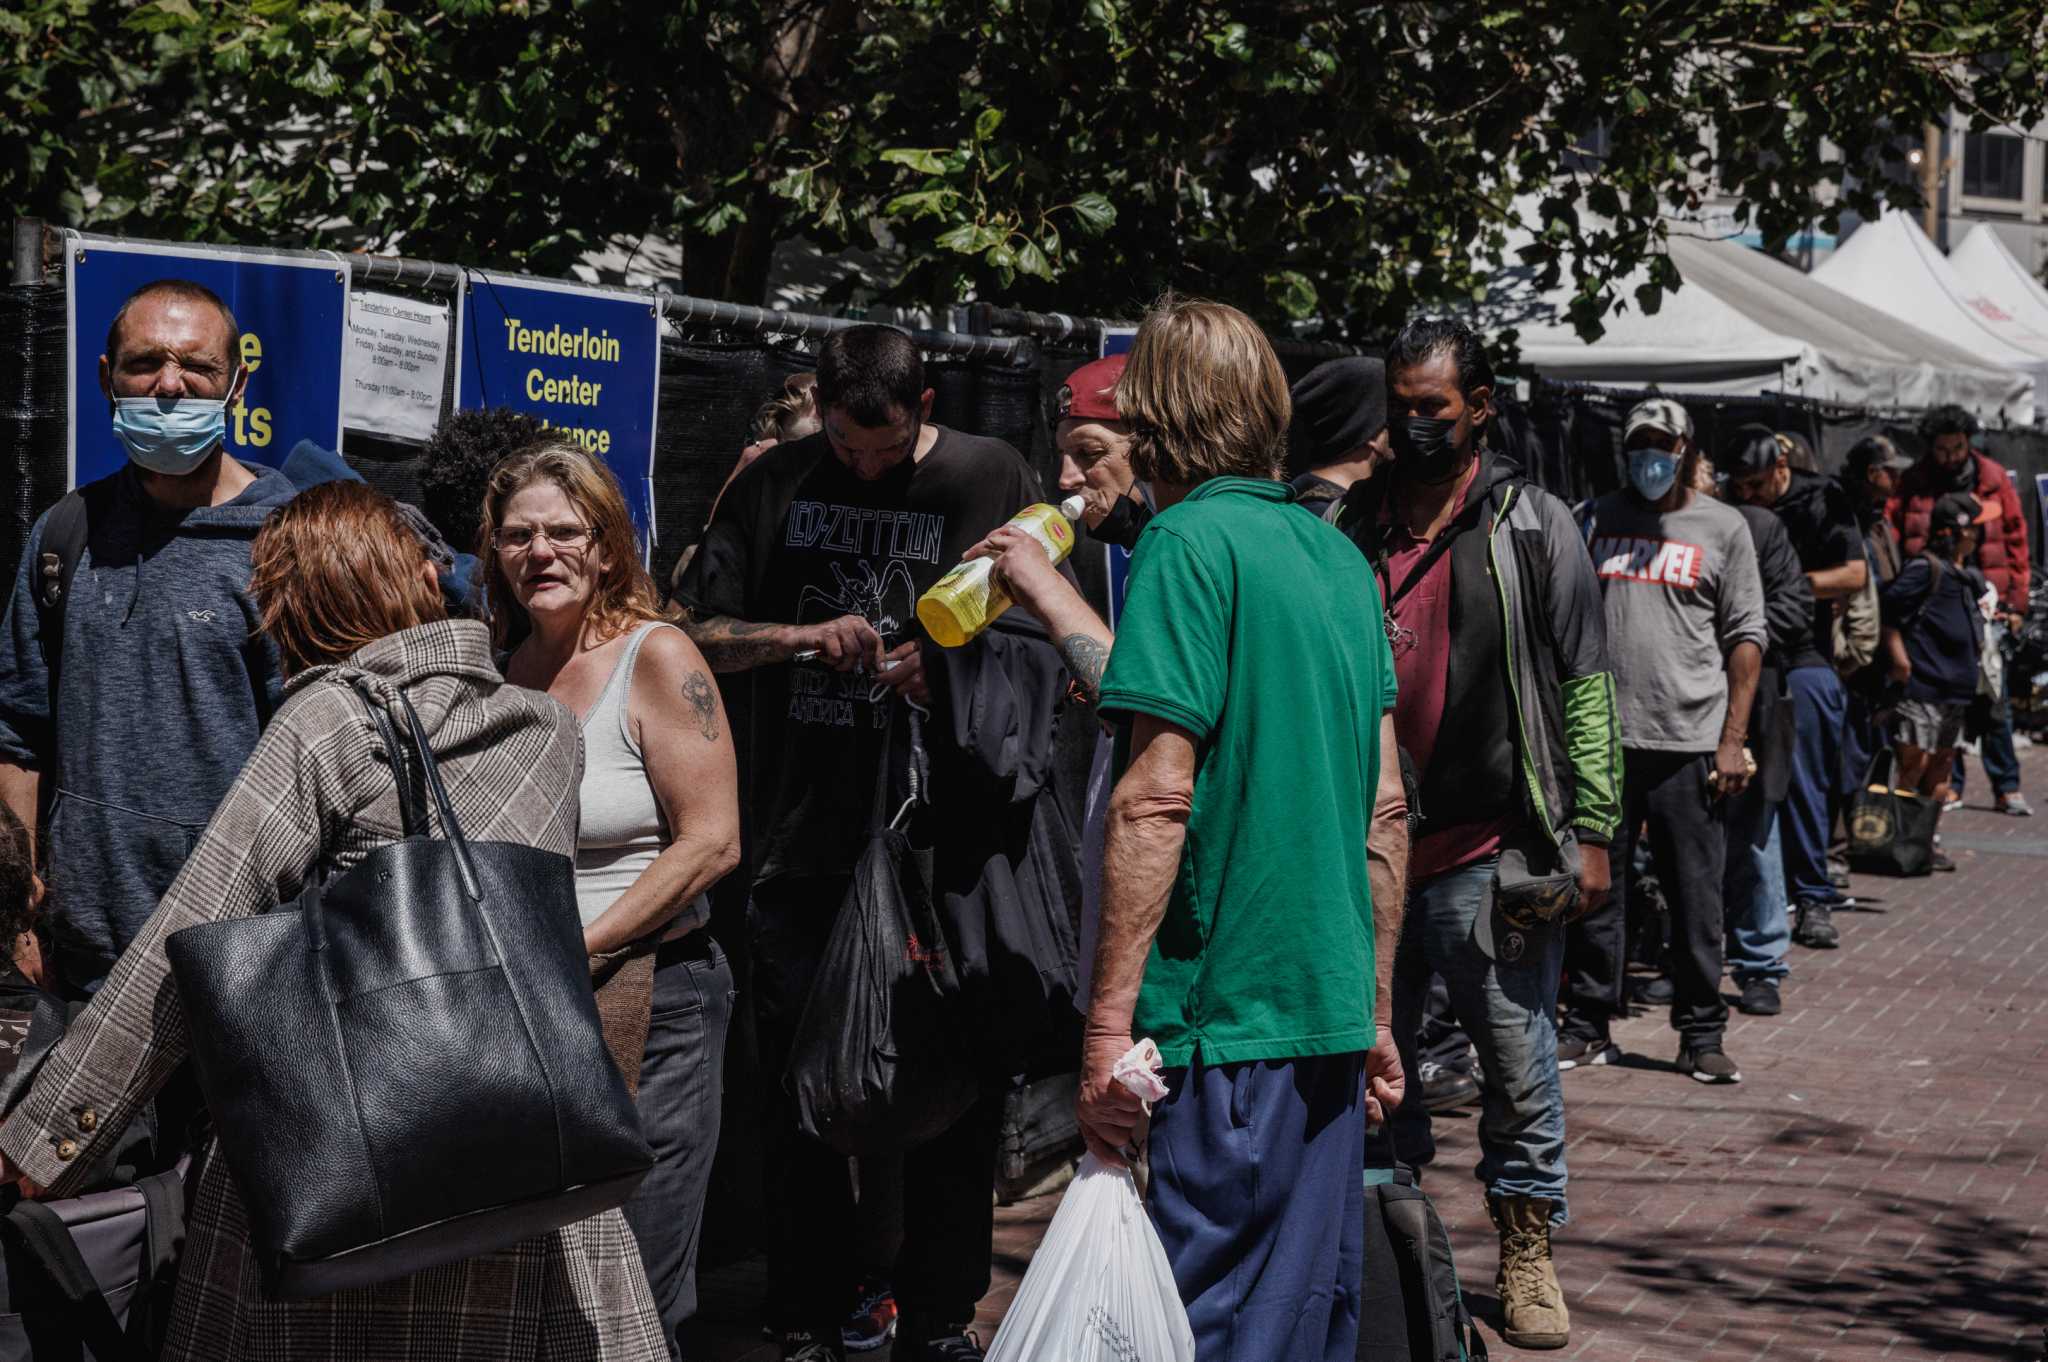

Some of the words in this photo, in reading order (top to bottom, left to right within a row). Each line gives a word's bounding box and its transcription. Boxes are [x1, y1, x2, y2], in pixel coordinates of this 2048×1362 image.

[360, 300, 391, 315] Tenderloin
[392, 306, 413, 319] Center
[414, 312, 432, 323] Hours
[504, 317, 620, 362] Tenderloin
[404, 350, 416, 361] and
[417, 351, 438, 366] Sunday
[355, 379, 380, 394] Thursday
[525, 368, 602, 407] Center
[1594, 538, 1698, 588] MARVEL
[786, 1332, 812, 1341] FILA
